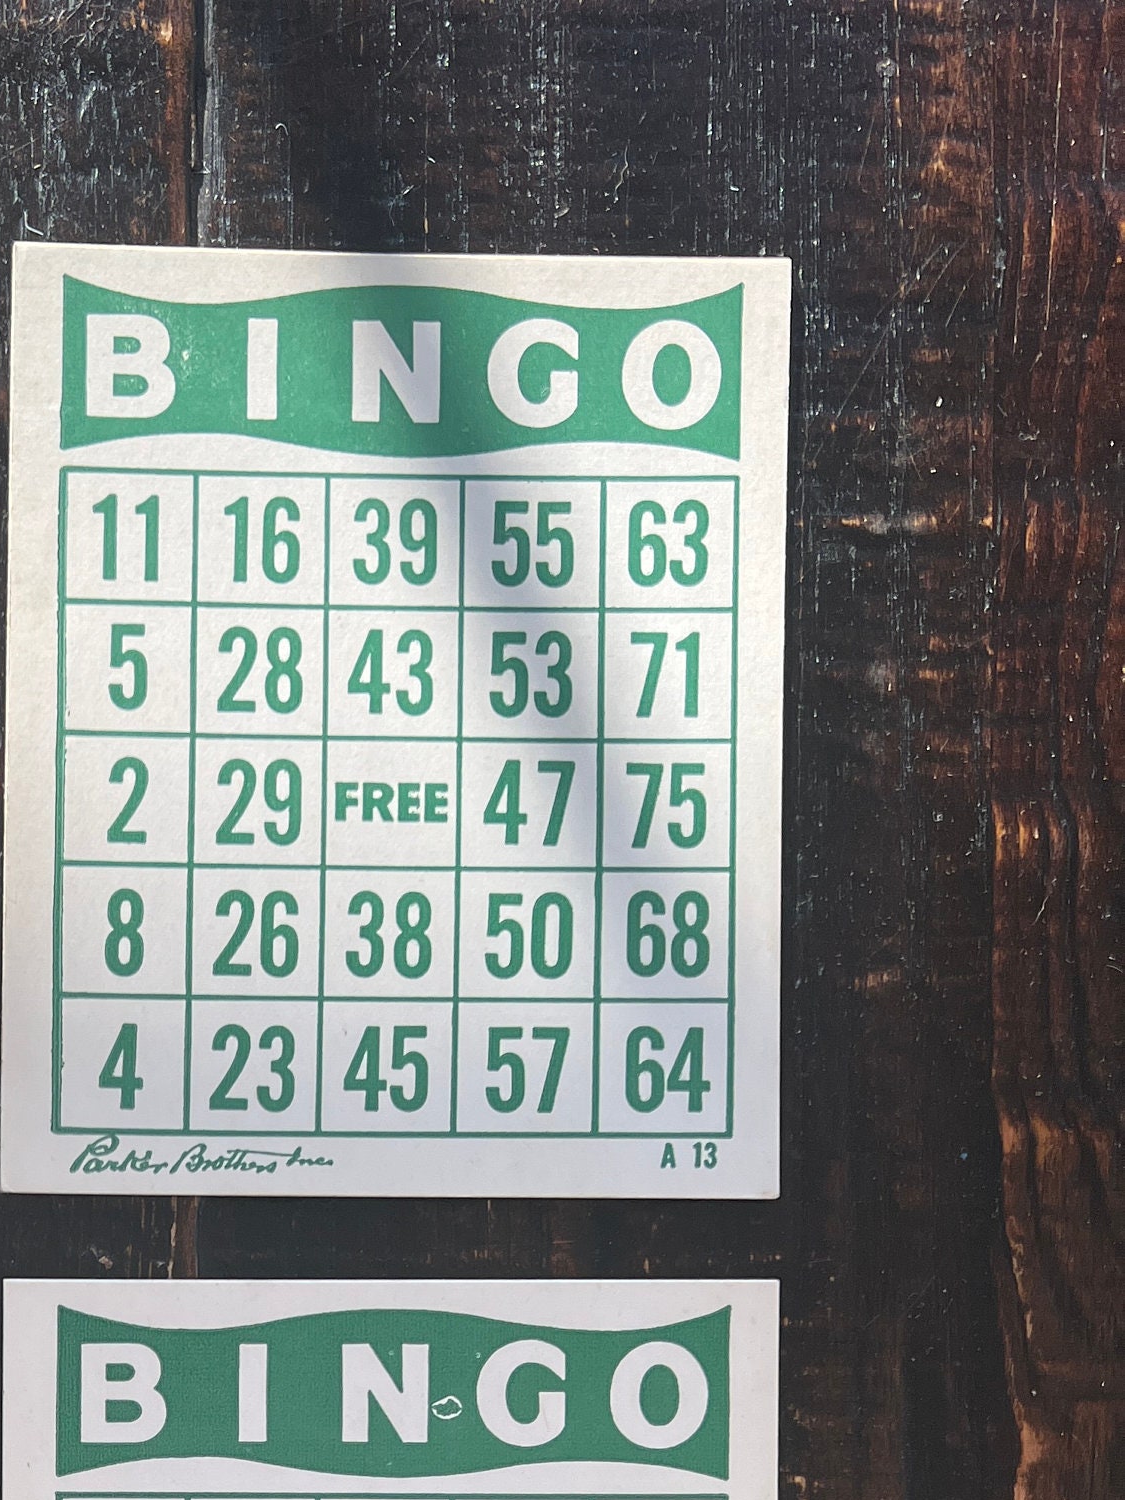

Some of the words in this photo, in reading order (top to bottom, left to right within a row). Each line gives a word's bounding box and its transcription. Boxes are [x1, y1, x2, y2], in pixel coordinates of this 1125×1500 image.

[85, 313, 723, 431] BINGO
[93, 494, 159, 582] 11
[224, 496, 300, 584] 16
[353, 498, 438, 586] 39
[491, 500, 574, 588] 55
[627, 499, 710, 587] 63
[109, 623, 148, 711] 5
[217, 626, 303, 714] 28
[347, 629, 433, 717] 43
[489, 630, 573, 719] 53
[630, 631, 700, 718] 71
[107, 757, 149, 844] 2
[215, 759, 302, 846] 29
[334, 782, 448, 823] FREE
[483, 760, 576, 846] 47
[626, 762, 707, 849] 75
[104, 888, 144, 977] 8
[212, 890, 299, 978] 26
[345, 890, 432, 979] 38
[485, 892, 574, 979] 50
[626, 890, 710, 978] 68
[98, 1023, 144, 1110] 4
[209, 1024, 295, 1113] 23
[343, 1025, 429, 1112] 45
[485, 1026, 570, 1113] 57
[625, 1026, 711, 1113] 64
[69, 1134, 168, 1174] Parker
[169, 1143, 278, 1175] Brothers
[660, 1142, 676, 1169] A
[692, 1141, 718, 1170] 13
[79, 1338, 710, 1450] BINGO
